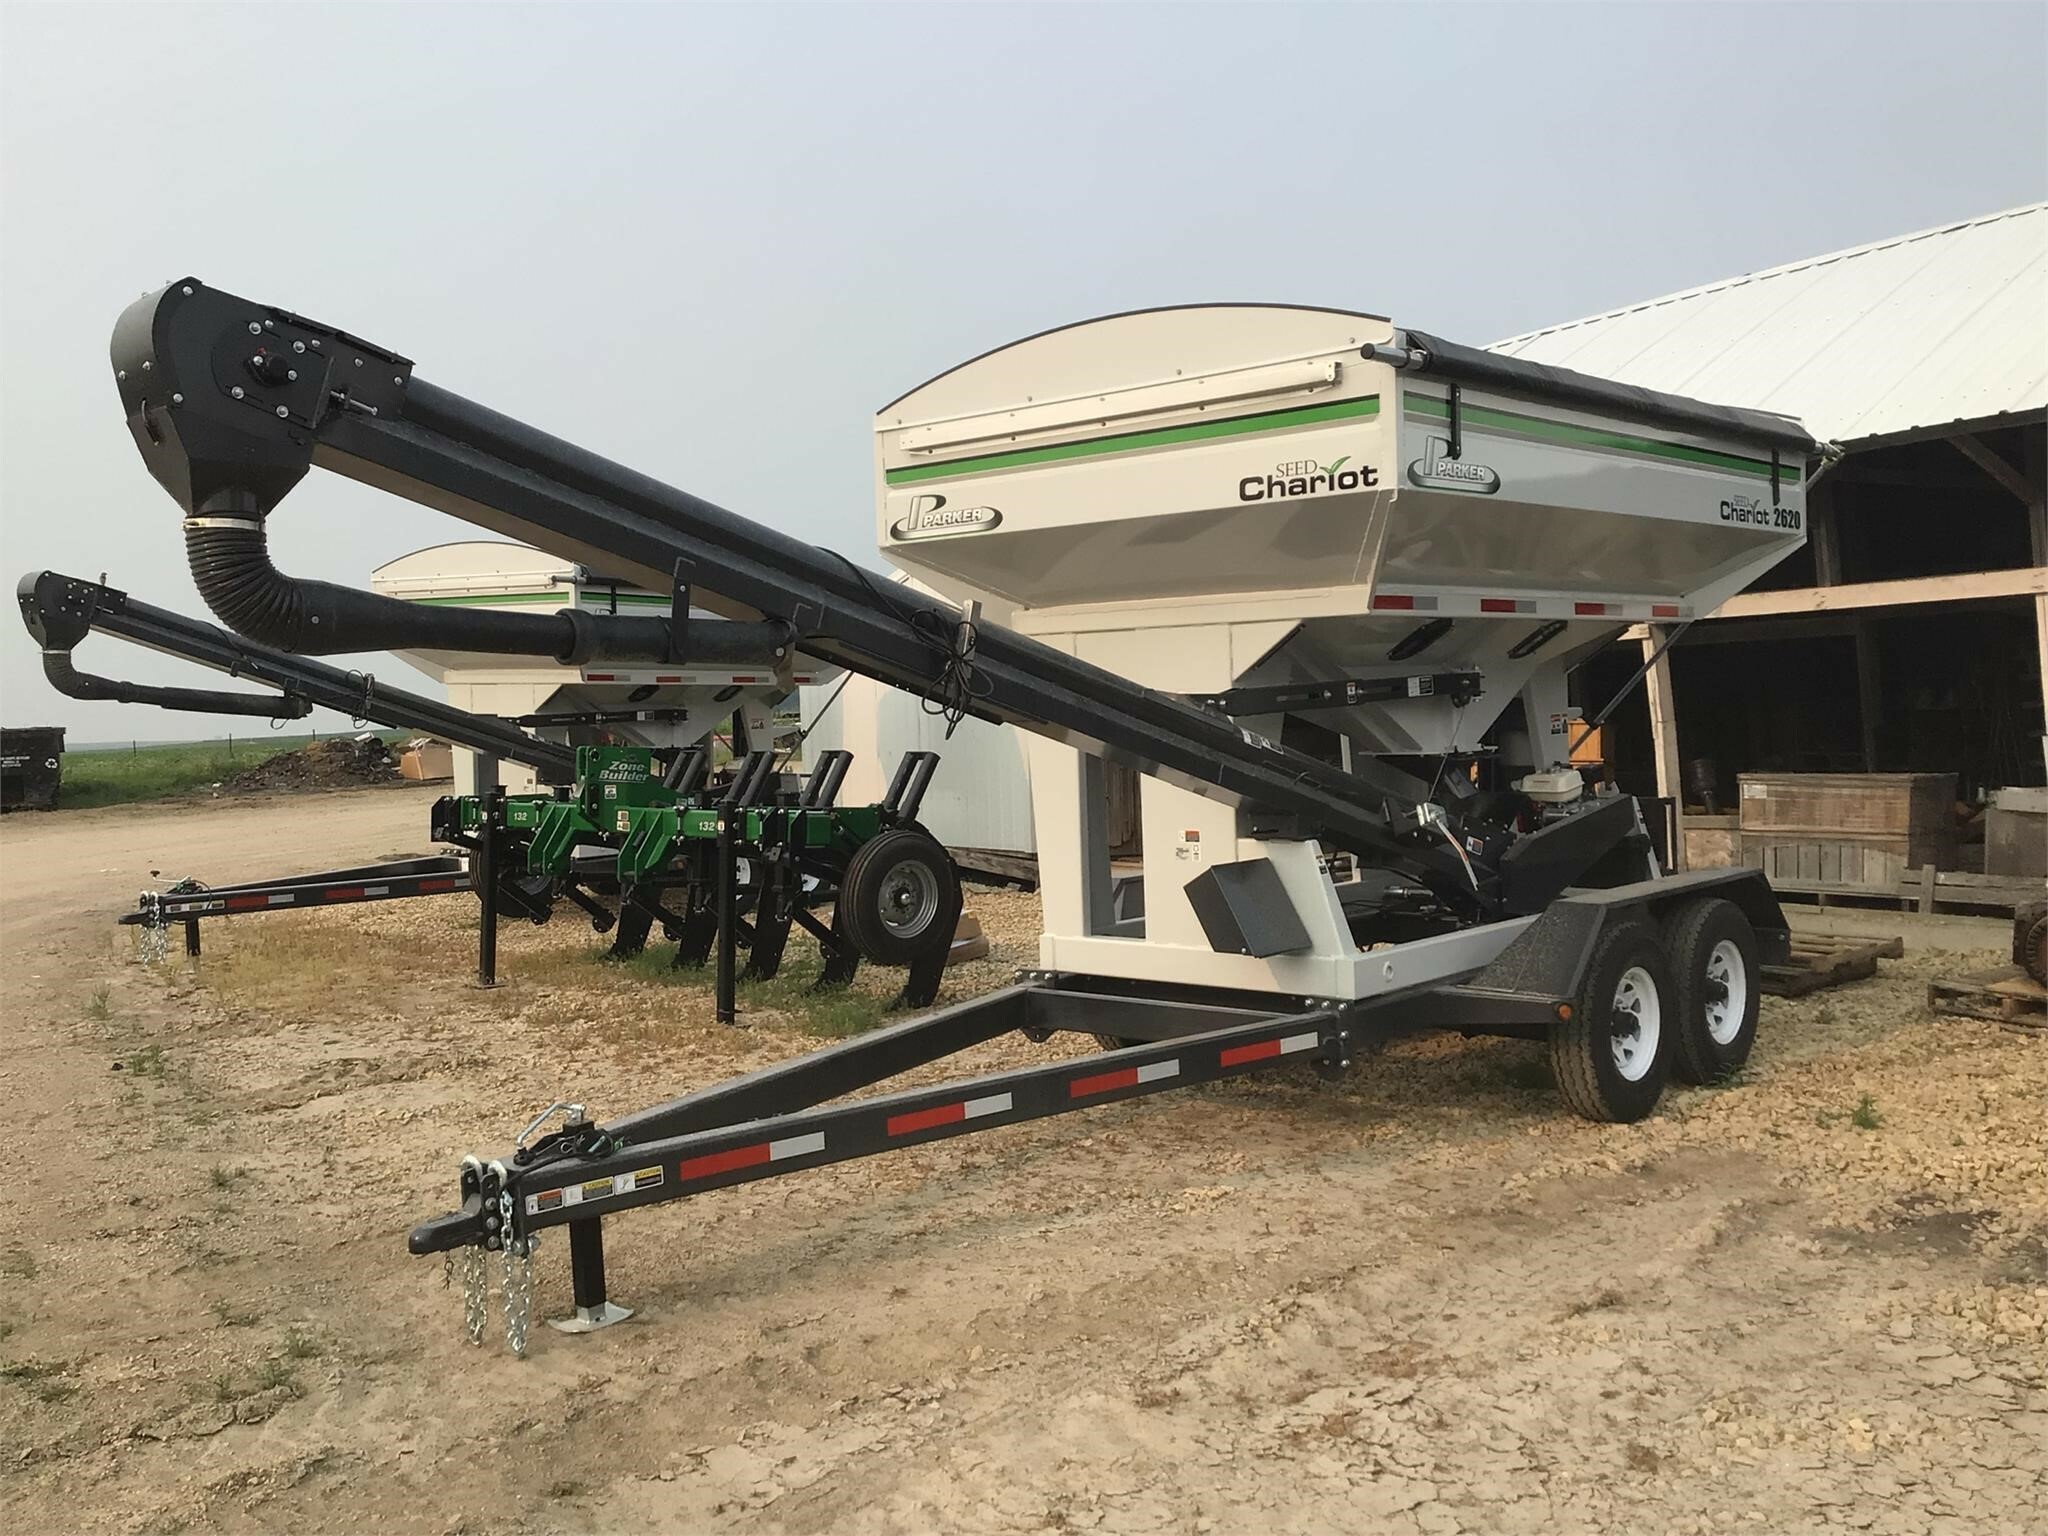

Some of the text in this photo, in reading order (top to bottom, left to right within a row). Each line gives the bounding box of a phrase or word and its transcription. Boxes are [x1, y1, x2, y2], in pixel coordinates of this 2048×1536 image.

[1276, 459, 1318, 478] SEED
[1436, 461, 1486, 481] PARKER
[1239, 465, 1379, 501] Chariot
[921, 509, 983, 528] PARKER
[1720, 500, 1802, 530] Chariot 2620
[599, 769, 650, 781] Builder
[608, 761, 647, 772] Zone
[514, 812, 528, 821] 132
[698, 821, 716, 832] 132
